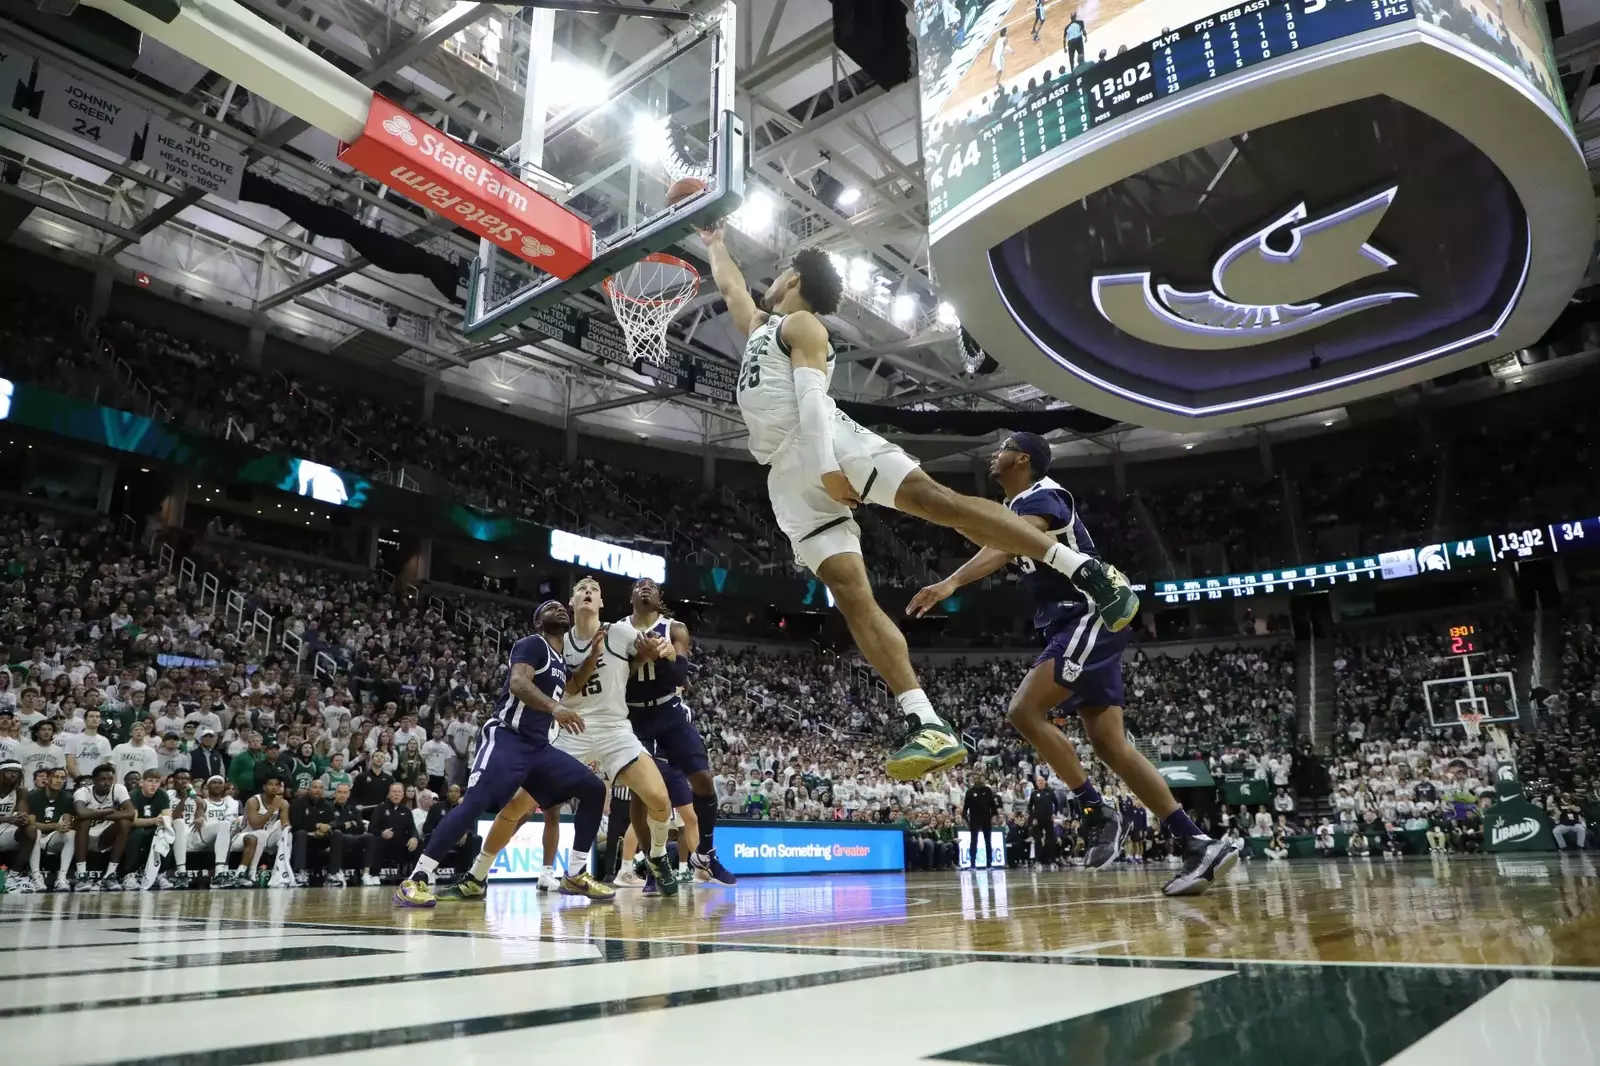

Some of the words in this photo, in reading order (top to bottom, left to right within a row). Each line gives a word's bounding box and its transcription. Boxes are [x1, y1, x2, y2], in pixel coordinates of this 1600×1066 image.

[1230, 22, 1235, 30] 2
[1284, 3, 1290, 11] 1
[1374, 12, 1381, 20] 3
[1384, 4, 1408, 17] FLS
[1152, 32, 1180, 50] PLYR
[1195, 19, 1214, 32] PTS
[1220, 9, 1241, 22] REB
[1244, 0, 1270, 14] ASST
[1166, 66, 1175, 75] 11
[1204, 50, 1214, 59] 11
[1233, 41, 1239, 49] 3
[1287, 22, 1295, 30] 0
[1167, 56, 1172, 64] 5
[1205, 41, 1211, 49] 8
[1231, 31, 1238, 39] 4
[1286, 12, 1292, 20] 3
[1167, 74, 1177, 84] 13
[1208, 60, 1214, 68] 0
[1234, 50, 1240, 58] 1
[1261, 40, 1268, 48] 0
[1289, 31, 1296, 39] 0
[1168, 83, 1179, 94] 23
[1209, 69, 1216, 77] 2
[1236, 59, 1243, 68] 5
[1263, 49, 1270, 58] 0
[1291, 41, 1298, 49] 3
[1091, 62, 1151, 101] 13:02
[65, 84, 121, 116] JOHNNY
[1037, 110, 1042, 118] 0
[1057, 99, 1062, 107] 0
[1112, 91, 1131, 104] 2ND
[1136, 92, 1153, 104] POSS
[68, 99, 114, 126] GREEN
[984, 123, 1003, 140] PLYR
[1013, 108, 1027, 122] PTS
[1031, 96, 1047, 111] REB
[1049, 84, 1069, 101] ASST
[1038, 118, 1043, 126] 0
[1095, 111, 1110, 122] POSS
[72, 118, 100, 141] 24
[1020, 138, 1025, 146] 2
[1039, 127, 1044, 135] 0
[1059, 116, 1064, 124] 0
[1040, 135, 1045, 143] 7
[1081, 114, 1086, 122] 0
[1041, 144, 1046, 152] 9
[1061, 134, 1066, 142] 2
[1082, 123, 1088, 131] 2
[158, 134, 234, 176] HEATHCOTE
[185, 136, 210, 152] JUD
[160, 150, 189, 168] HEAD
[191, 163, 228, 185] COACH
[948, 140, 981, 178] 44
[196, 176, 220, 192] 1995
[536, 312, 576, 333] AMPIONS
[538, 322, 562, 339] 2005
[589, 317, 619, 330] WOMEN'S
[657, 371, 675, 383] 2011
[702, 362, 738, 378] WOMEN'S
[705, 370, 718, 380] BIG
[720, 374, 735, 384] TEN
[696, 375, 737, 391] CHAMPION
[710, 388, 731, 400] 2014
[1455, 540, 1475, 558] 44
[1498, 529, 1544, 551] 13:02
[1562, 521, 1585, 540] 34
[551, 529, 665, 584] SPARTANS
[1492, 821, 1534, 845] LIBMAN
[734, 844, 759, 858] Plan
[760, 844, 777, 857] On
[777, 844, 832, 861] Something
[832, 845, 870, 857] Greater
